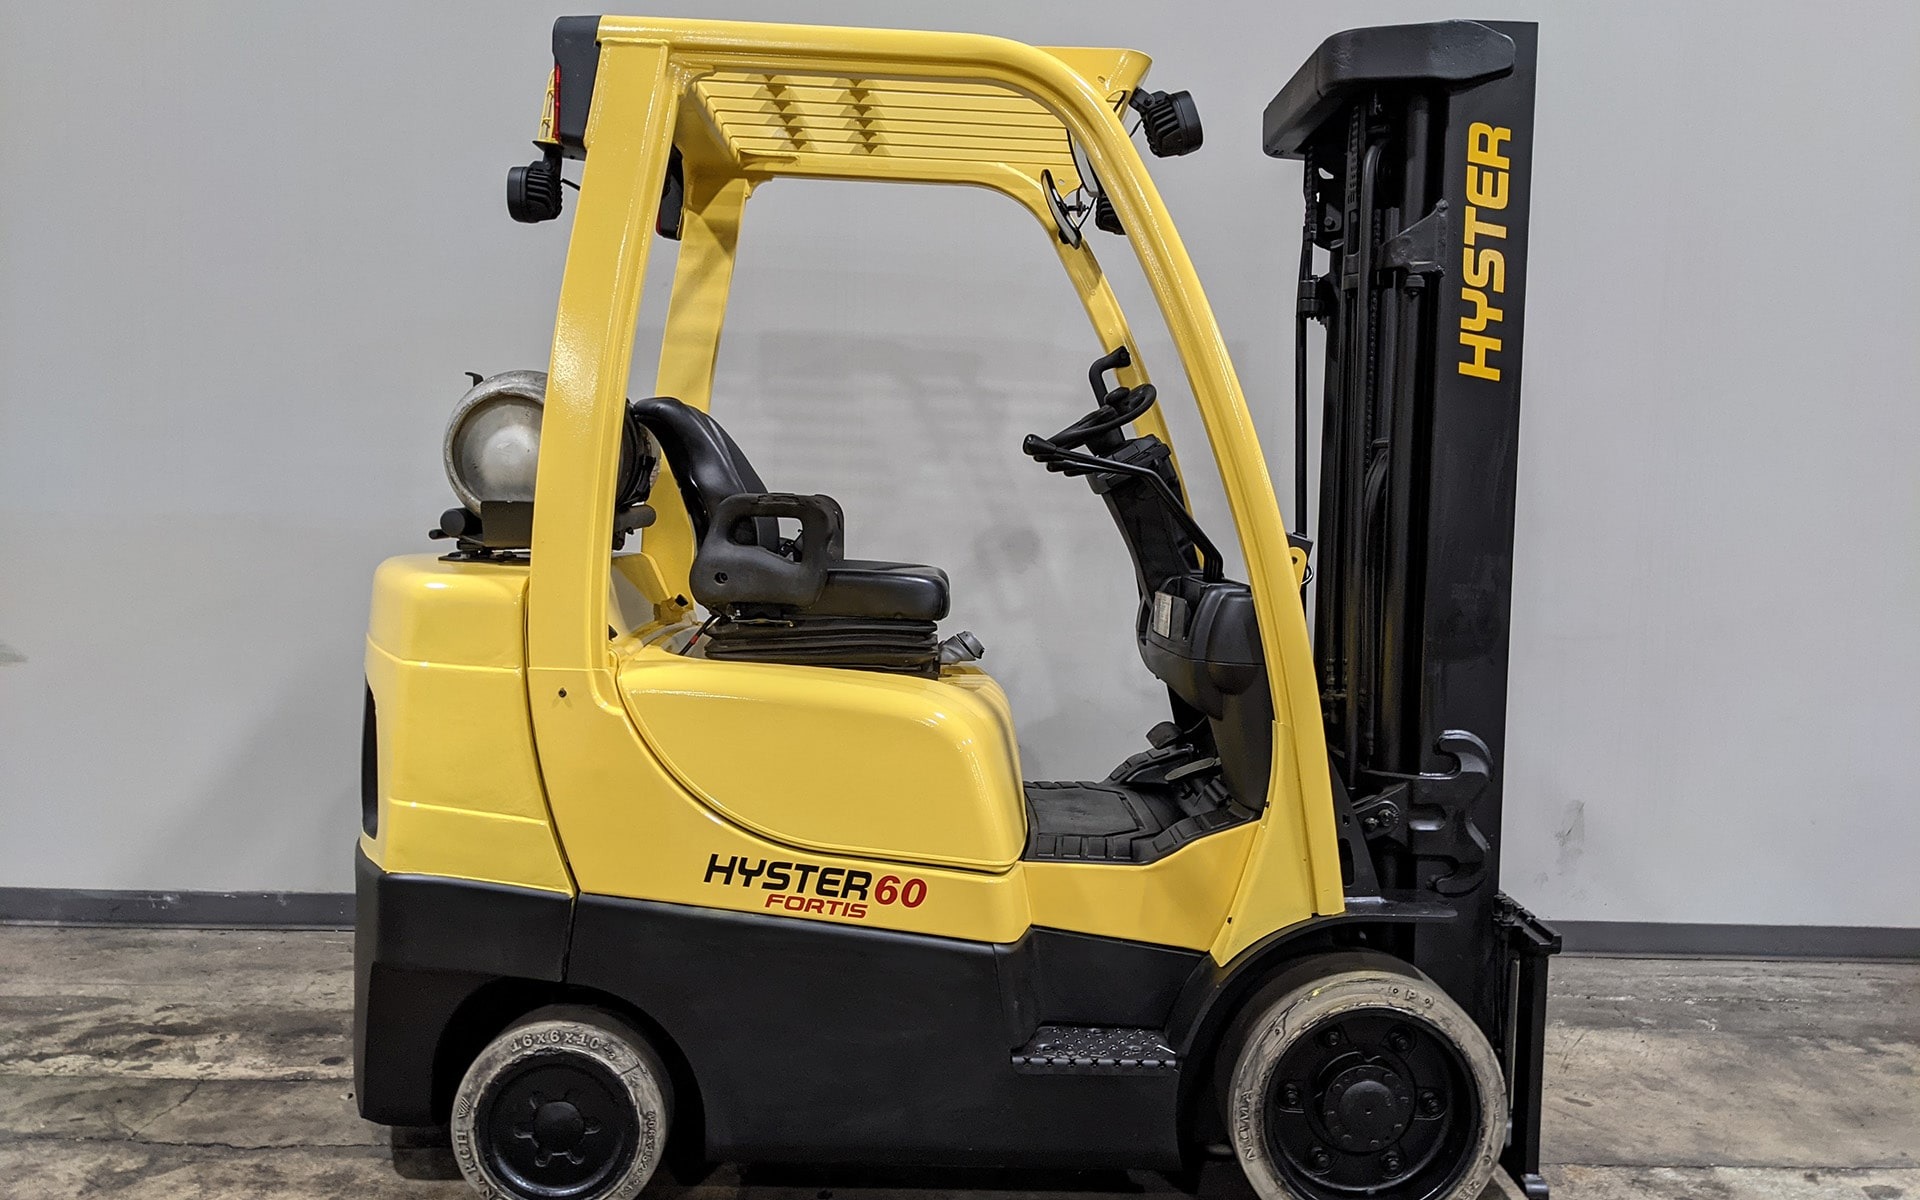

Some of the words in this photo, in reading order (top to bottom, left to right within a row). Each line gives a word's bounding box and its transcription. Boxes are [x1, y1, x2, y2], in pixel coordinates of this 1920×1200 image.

[1458, 122, 1511, 382] HYSTER
[703, 853, 873, 901] HYSTER
[874, 875, 928, 908] 60
[765, 894, 868, 918] FORTIS
